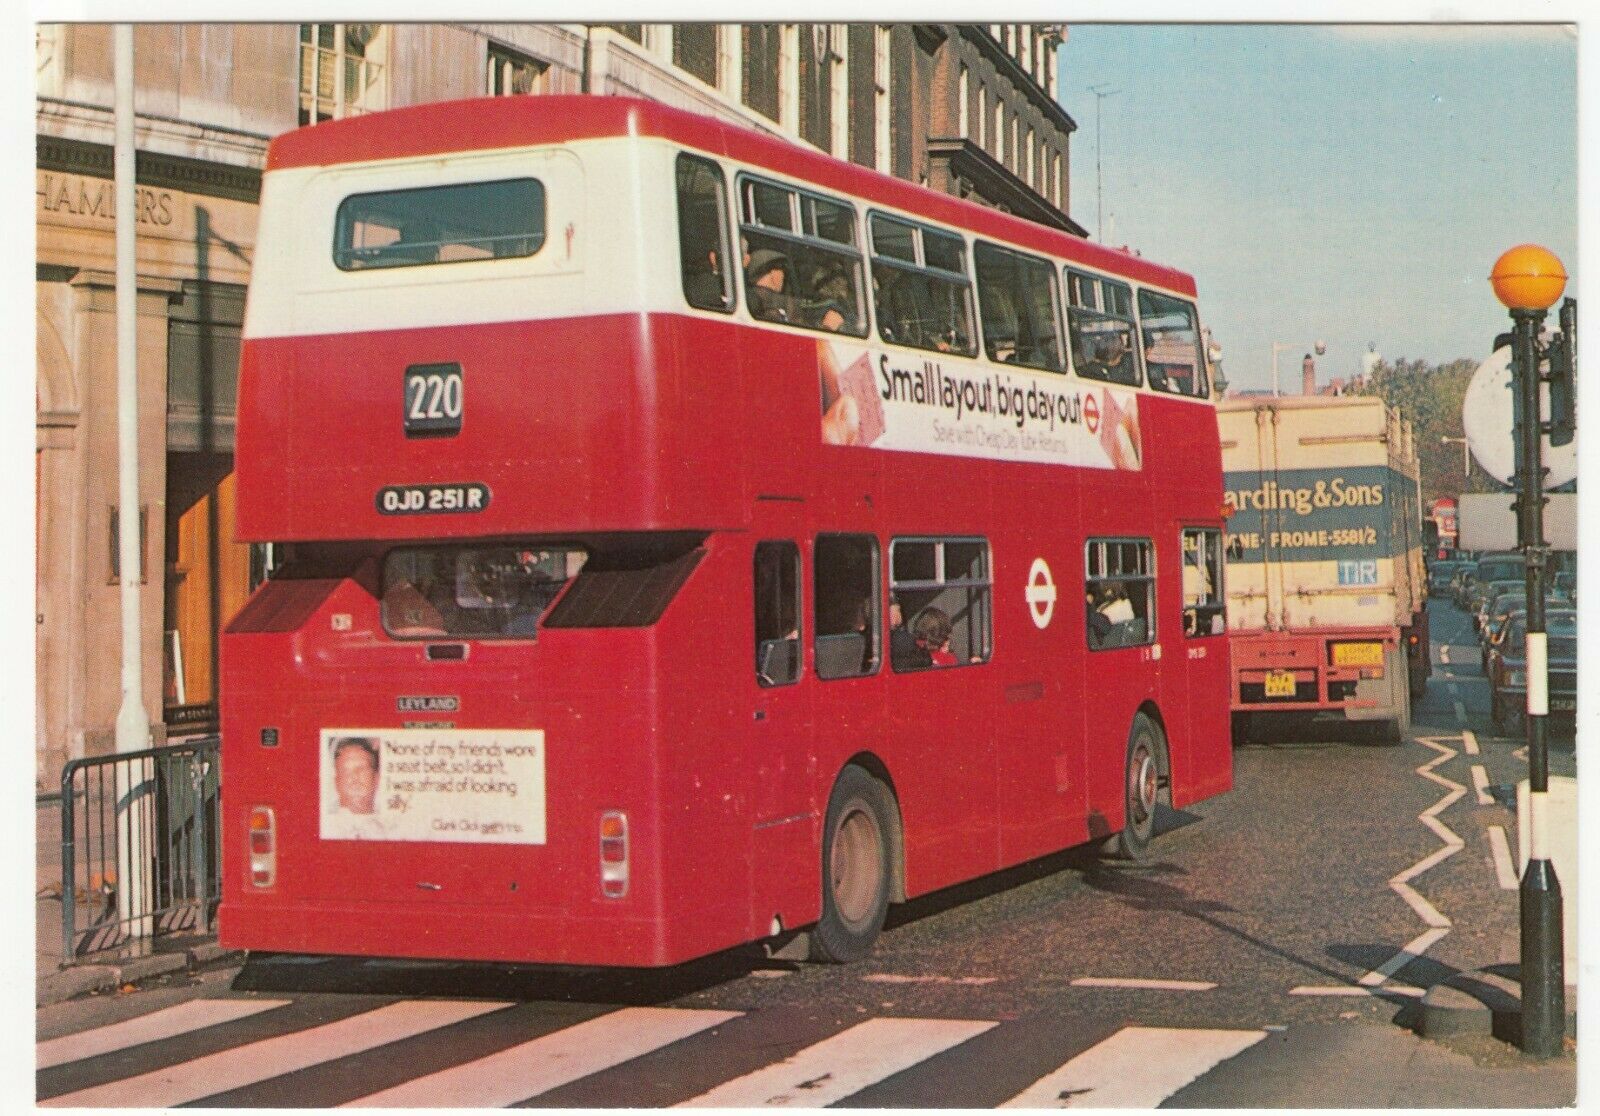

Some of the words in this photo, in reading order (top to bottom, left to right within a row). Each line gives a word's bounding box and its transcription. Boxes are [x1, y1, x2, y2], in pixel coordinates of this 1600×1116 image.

[409, 374, 462, 419] 220
[880, 353, 936, 405] Small
[995, 374, 1025, 428] big
[1027, 380, 1054, 432] day
[1057, 392, 1082, 424] out
[383, 490, 425, 511] OJD
[428, 488, 464, 509] 251
[467, 487, 483, 508] R
[1339, 560, 1377, 585] TIR
[399, 698, 457, 711] LEYLAND
[423, 740, 436, 756] of
[439, 745, 456, 759] my
[458, 740, 502, 756] friends
[503, 745, 537, 757] wore
[396, 761, 421, 774] seat
[392, 780, 416, 792] was
[418, 776, 454, 792] afraid
[456, 776, 470, 792] of
[469, 776, 519, 798] looking
